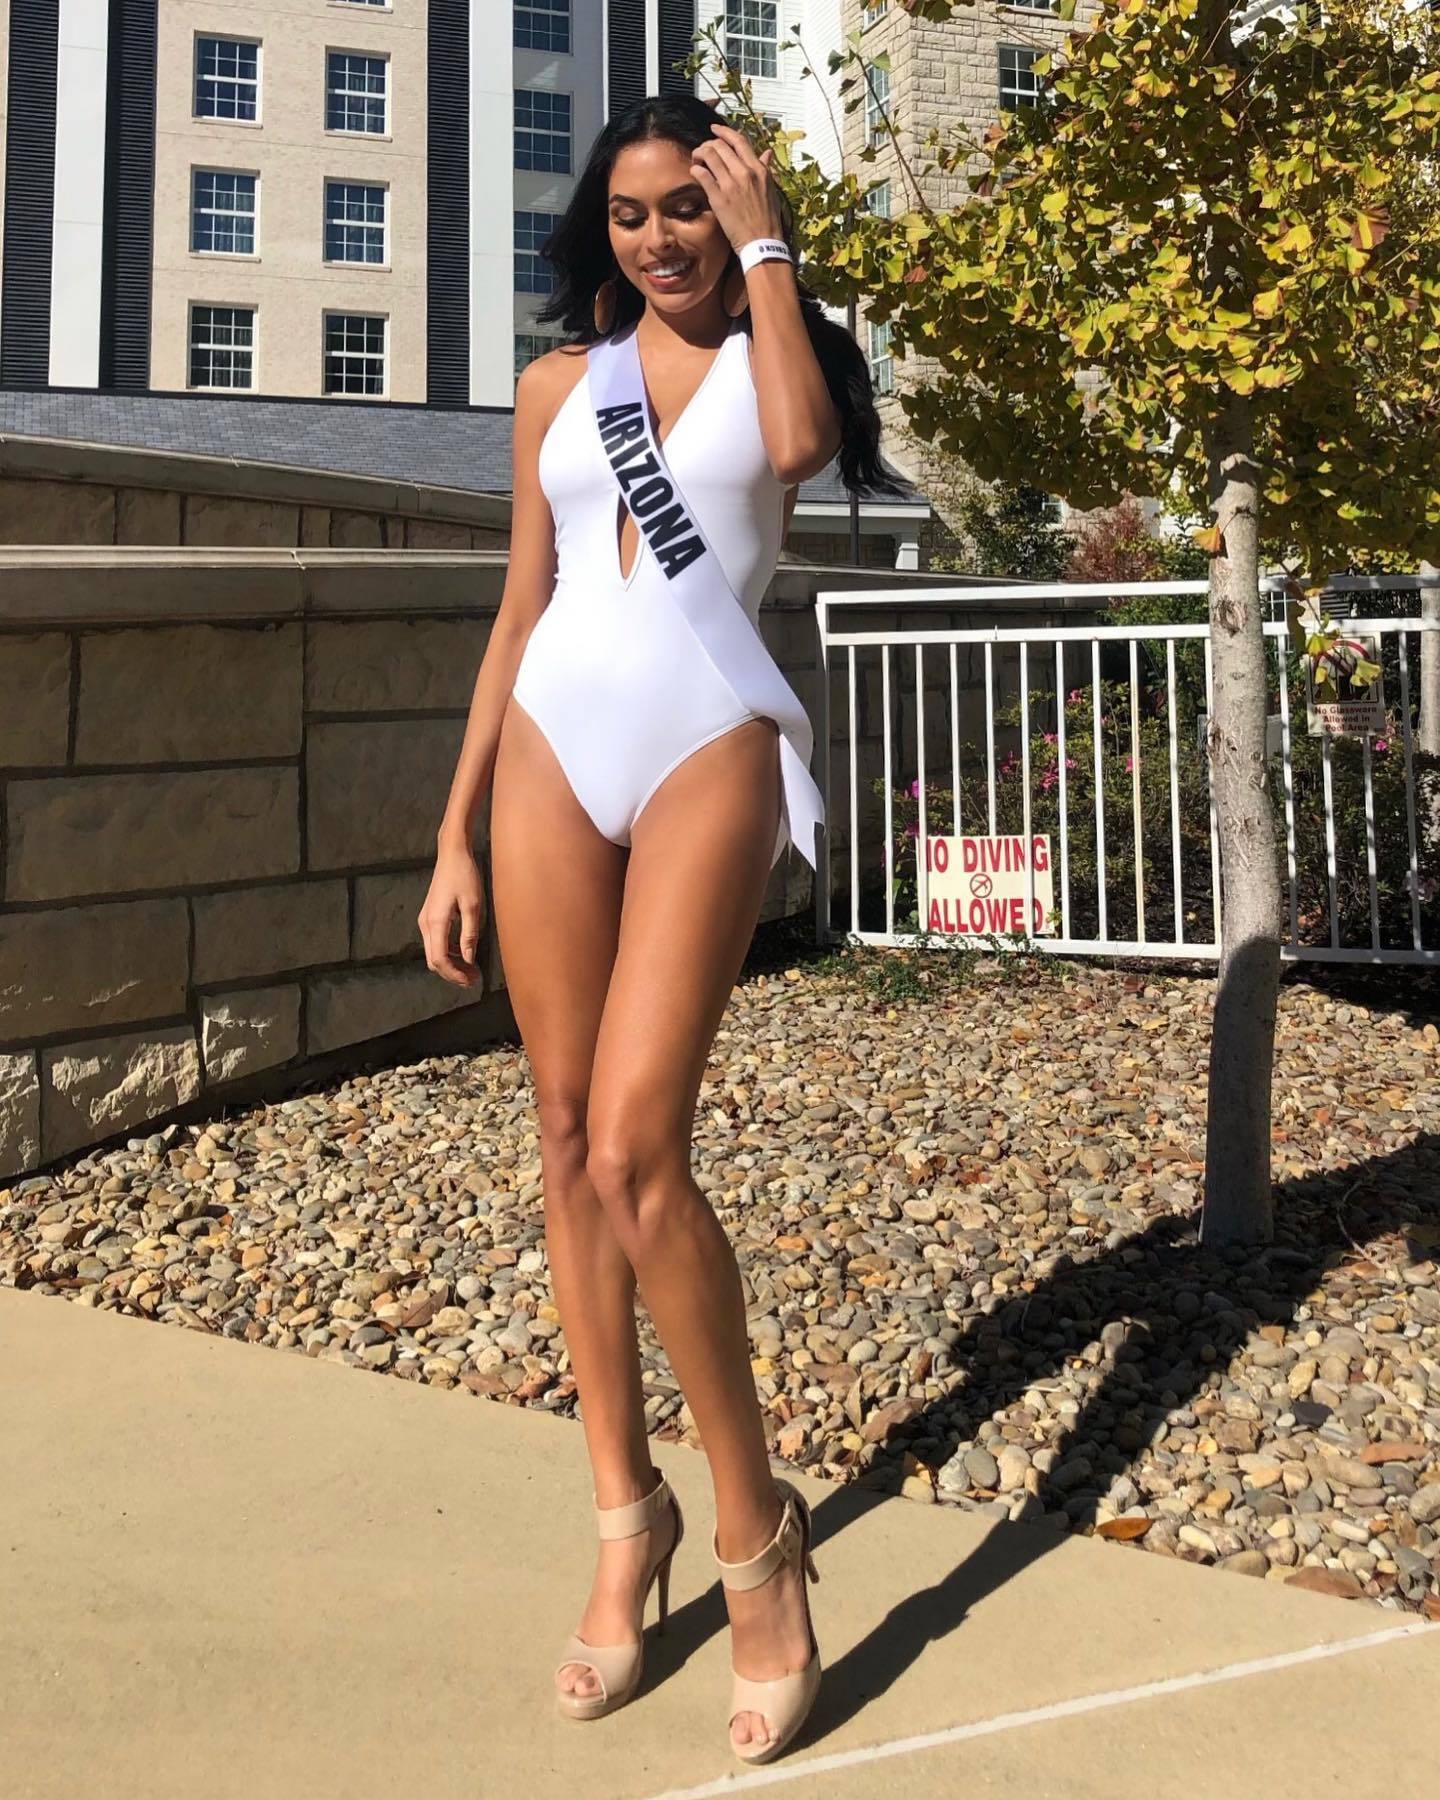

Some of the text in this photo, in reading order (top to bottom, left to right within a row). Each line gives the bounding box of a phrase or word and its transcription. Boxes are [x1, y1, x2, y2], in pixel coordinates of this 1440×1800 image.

[596, 402, 707, 581] ARIZONA
[1314, 706, 1377, 714] No Glassware
[1325, 724, 1369, 732] Pool Area
[962, 836, 1049, 873] DIVING
[928, 898, 1043, 933] ALLOWED
